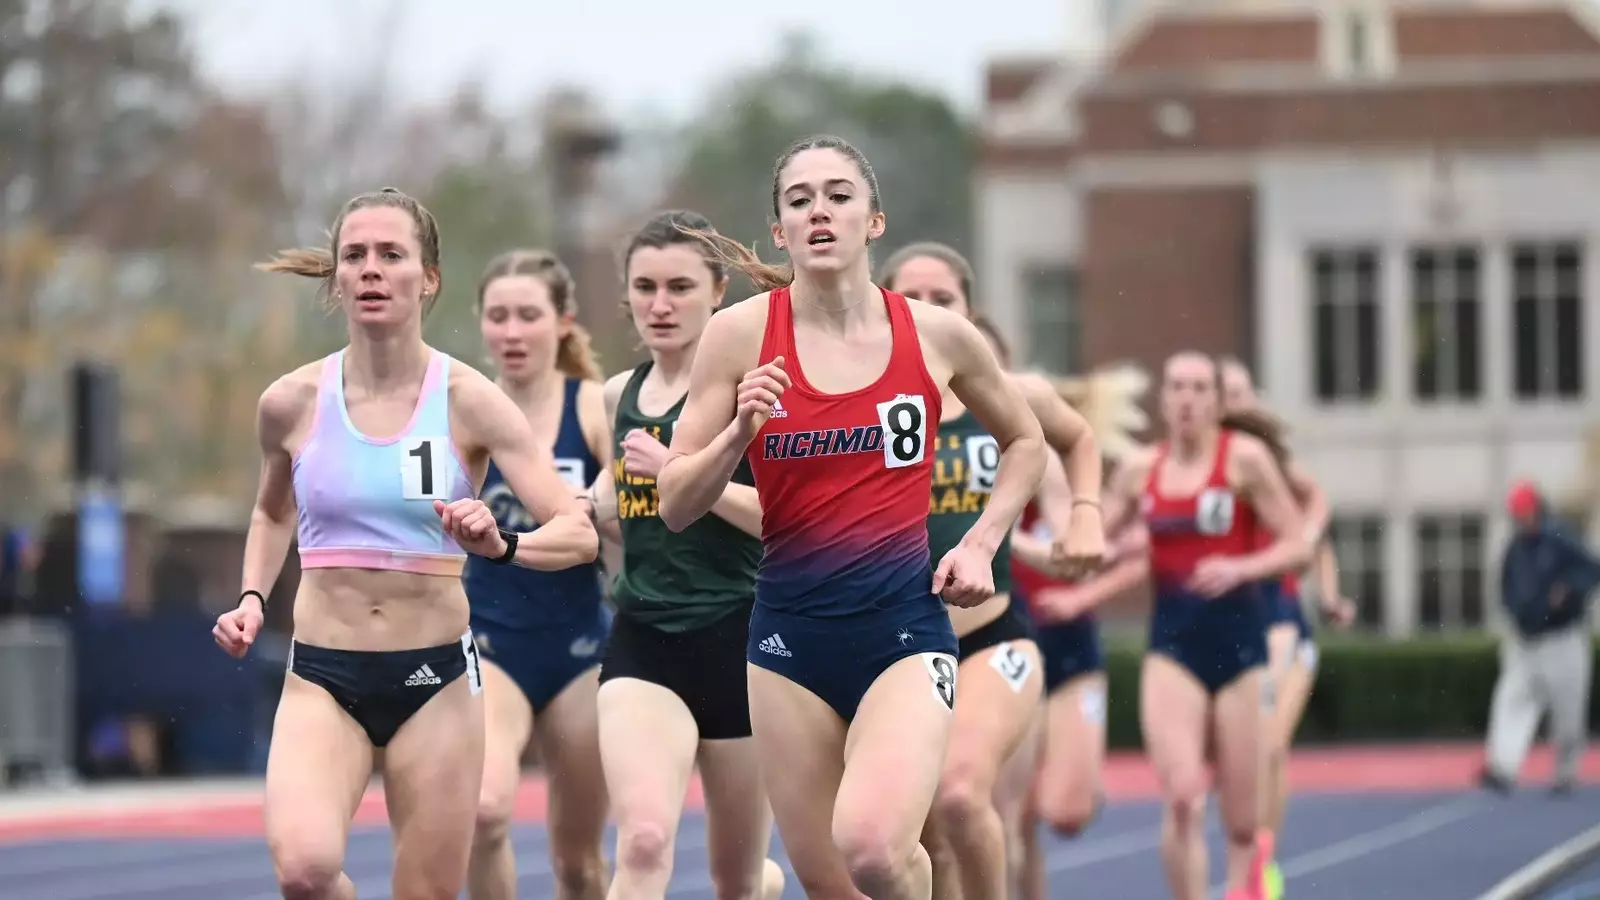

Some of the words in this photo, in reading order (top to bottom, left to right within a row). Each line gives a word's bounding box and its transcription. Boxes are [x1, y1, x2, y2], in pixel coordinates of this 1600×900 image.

[770, 409, 788, 418] das
[888, 402, 922, 461] 8
[763, 425, 885, 460] RICHMO
[977, 442, 1000, 488] 9
[409, 440, 434, 495] 1
[467, 635, 482, 688] 1
[757, 641, 793, 658] adidas
[404, 676, 442, 687] adidas
[932, 656, 955, 711] 8
